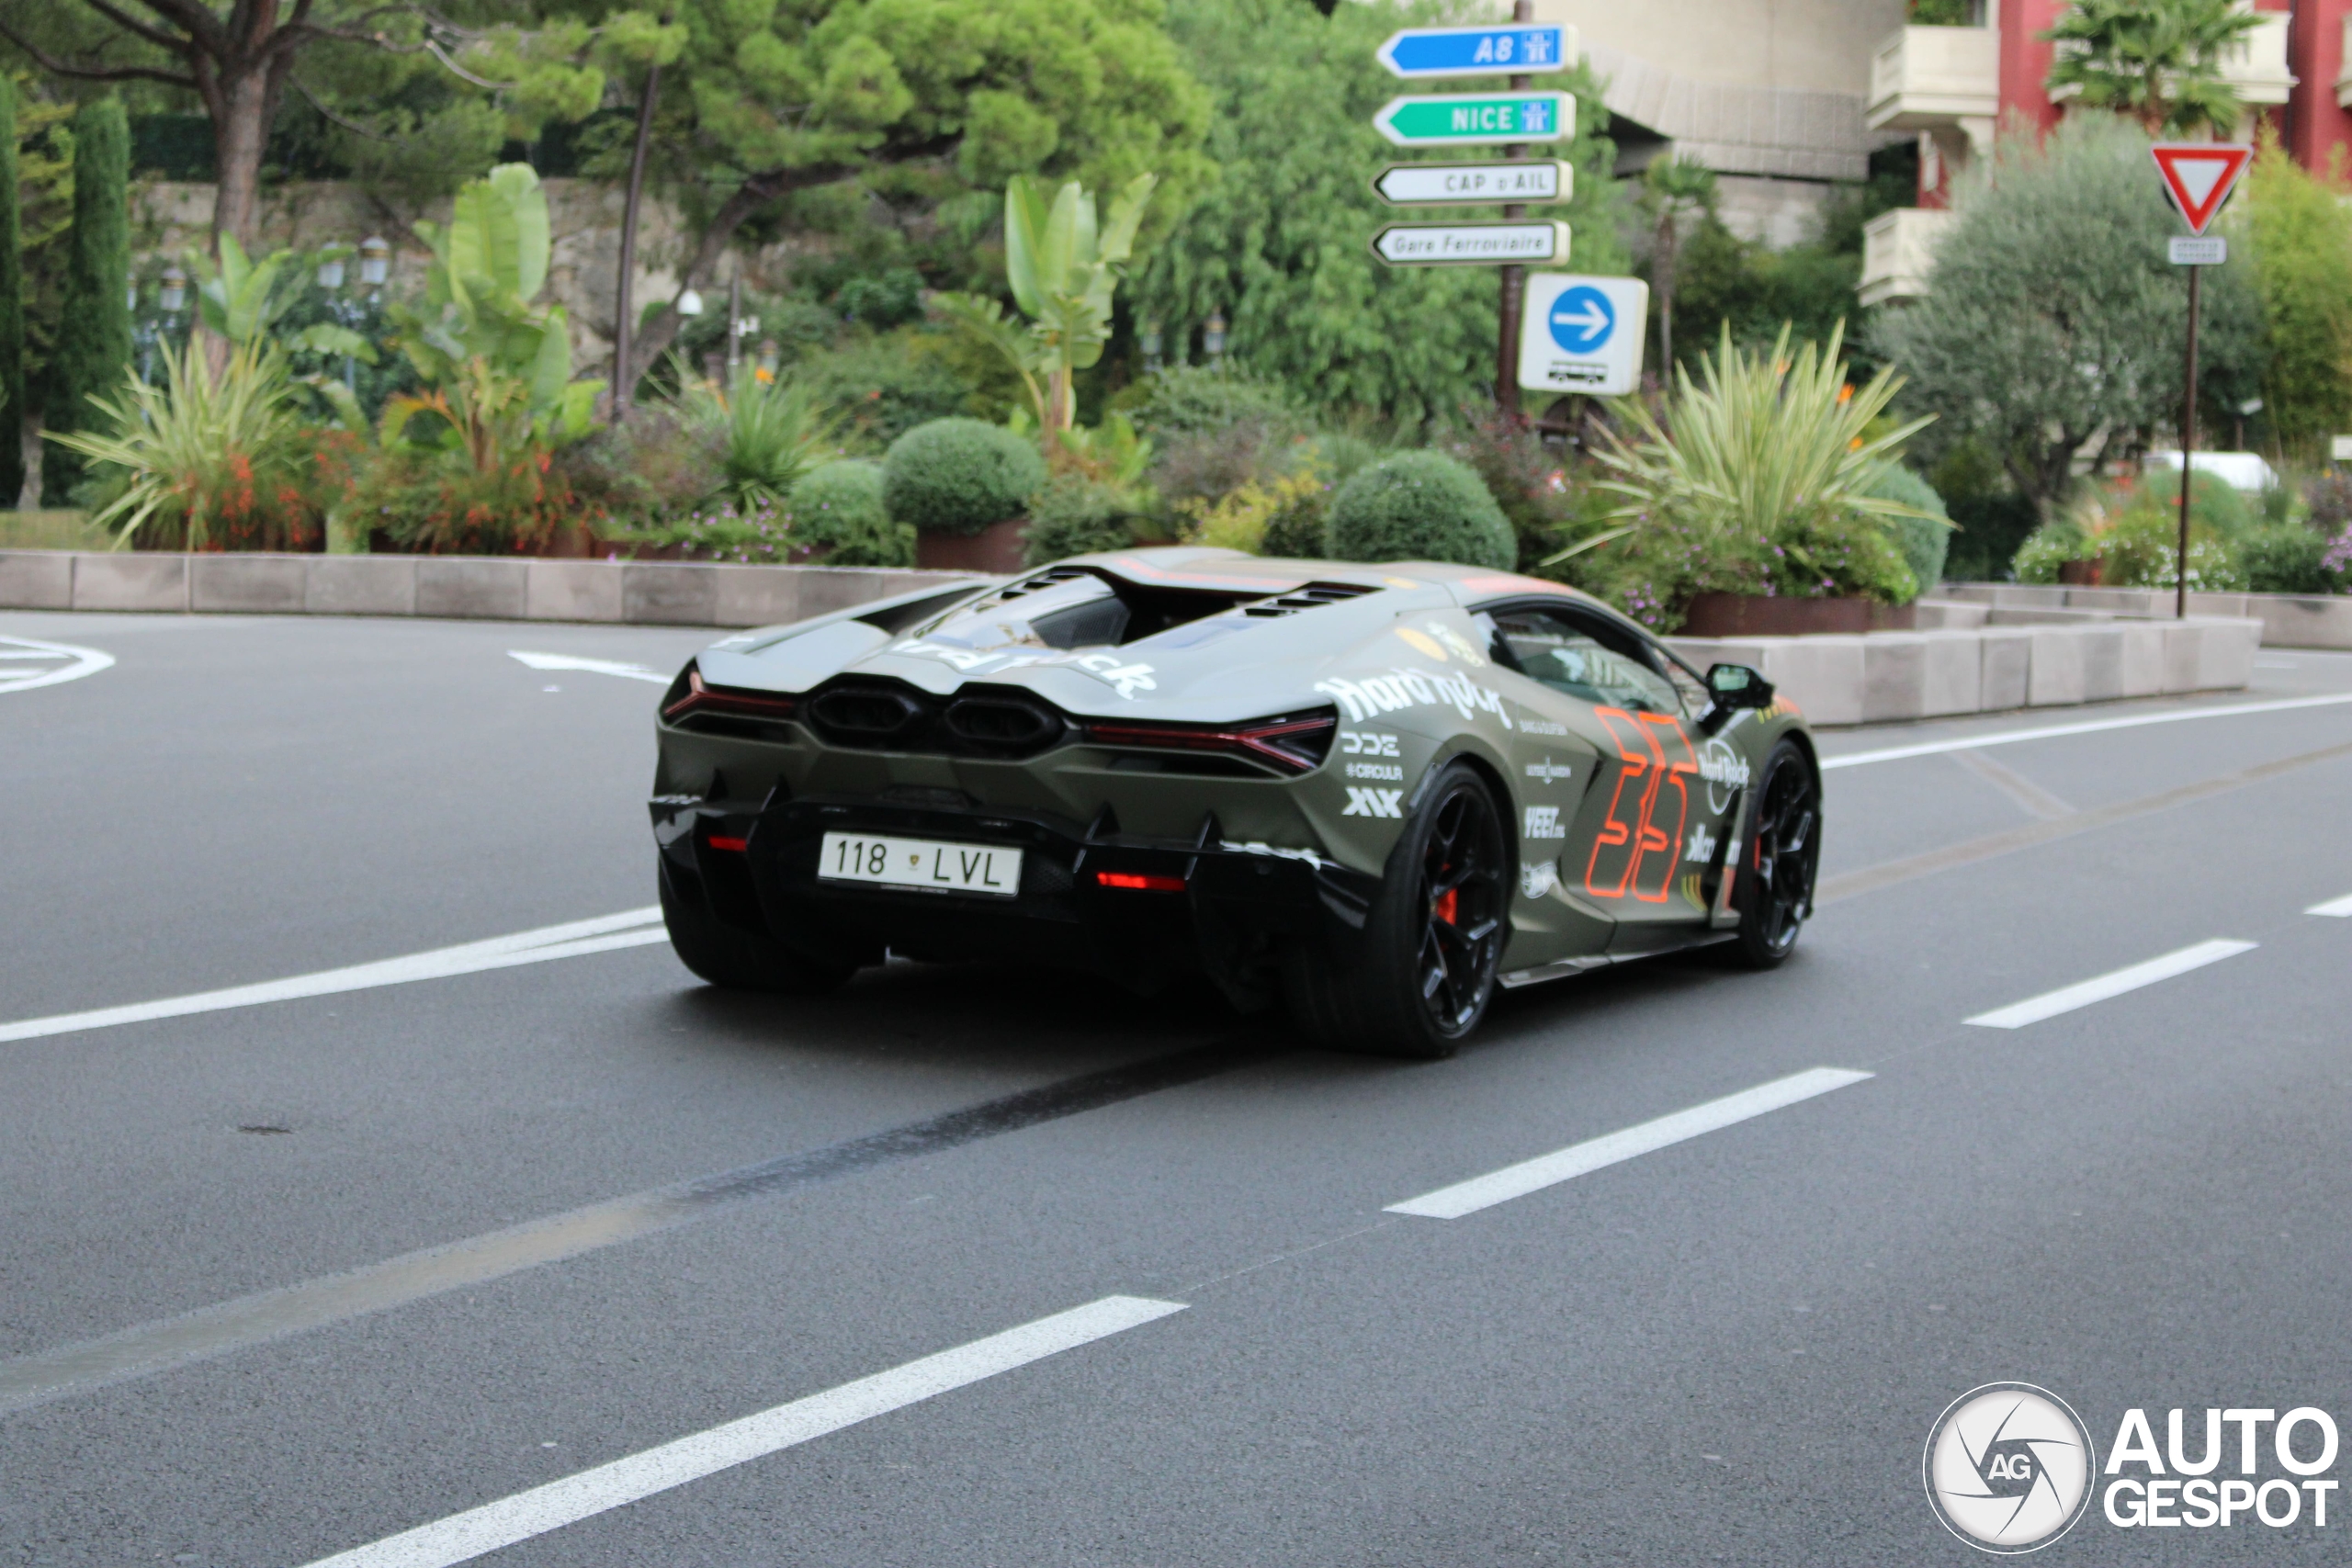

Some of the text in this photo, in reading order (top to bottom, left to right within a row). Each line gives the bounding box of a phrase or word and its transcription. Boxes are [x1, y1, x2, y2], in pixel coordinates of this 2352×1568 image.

[1473, 36, 1515, 63] A8
[1452, 106, 1513, 130] NICE
[1445, 174, 1487, 192] CAP
[1394, 232, 1544, 254] Gare Ferroviaire
[838, 840, 1001, 888] 118 LVL
